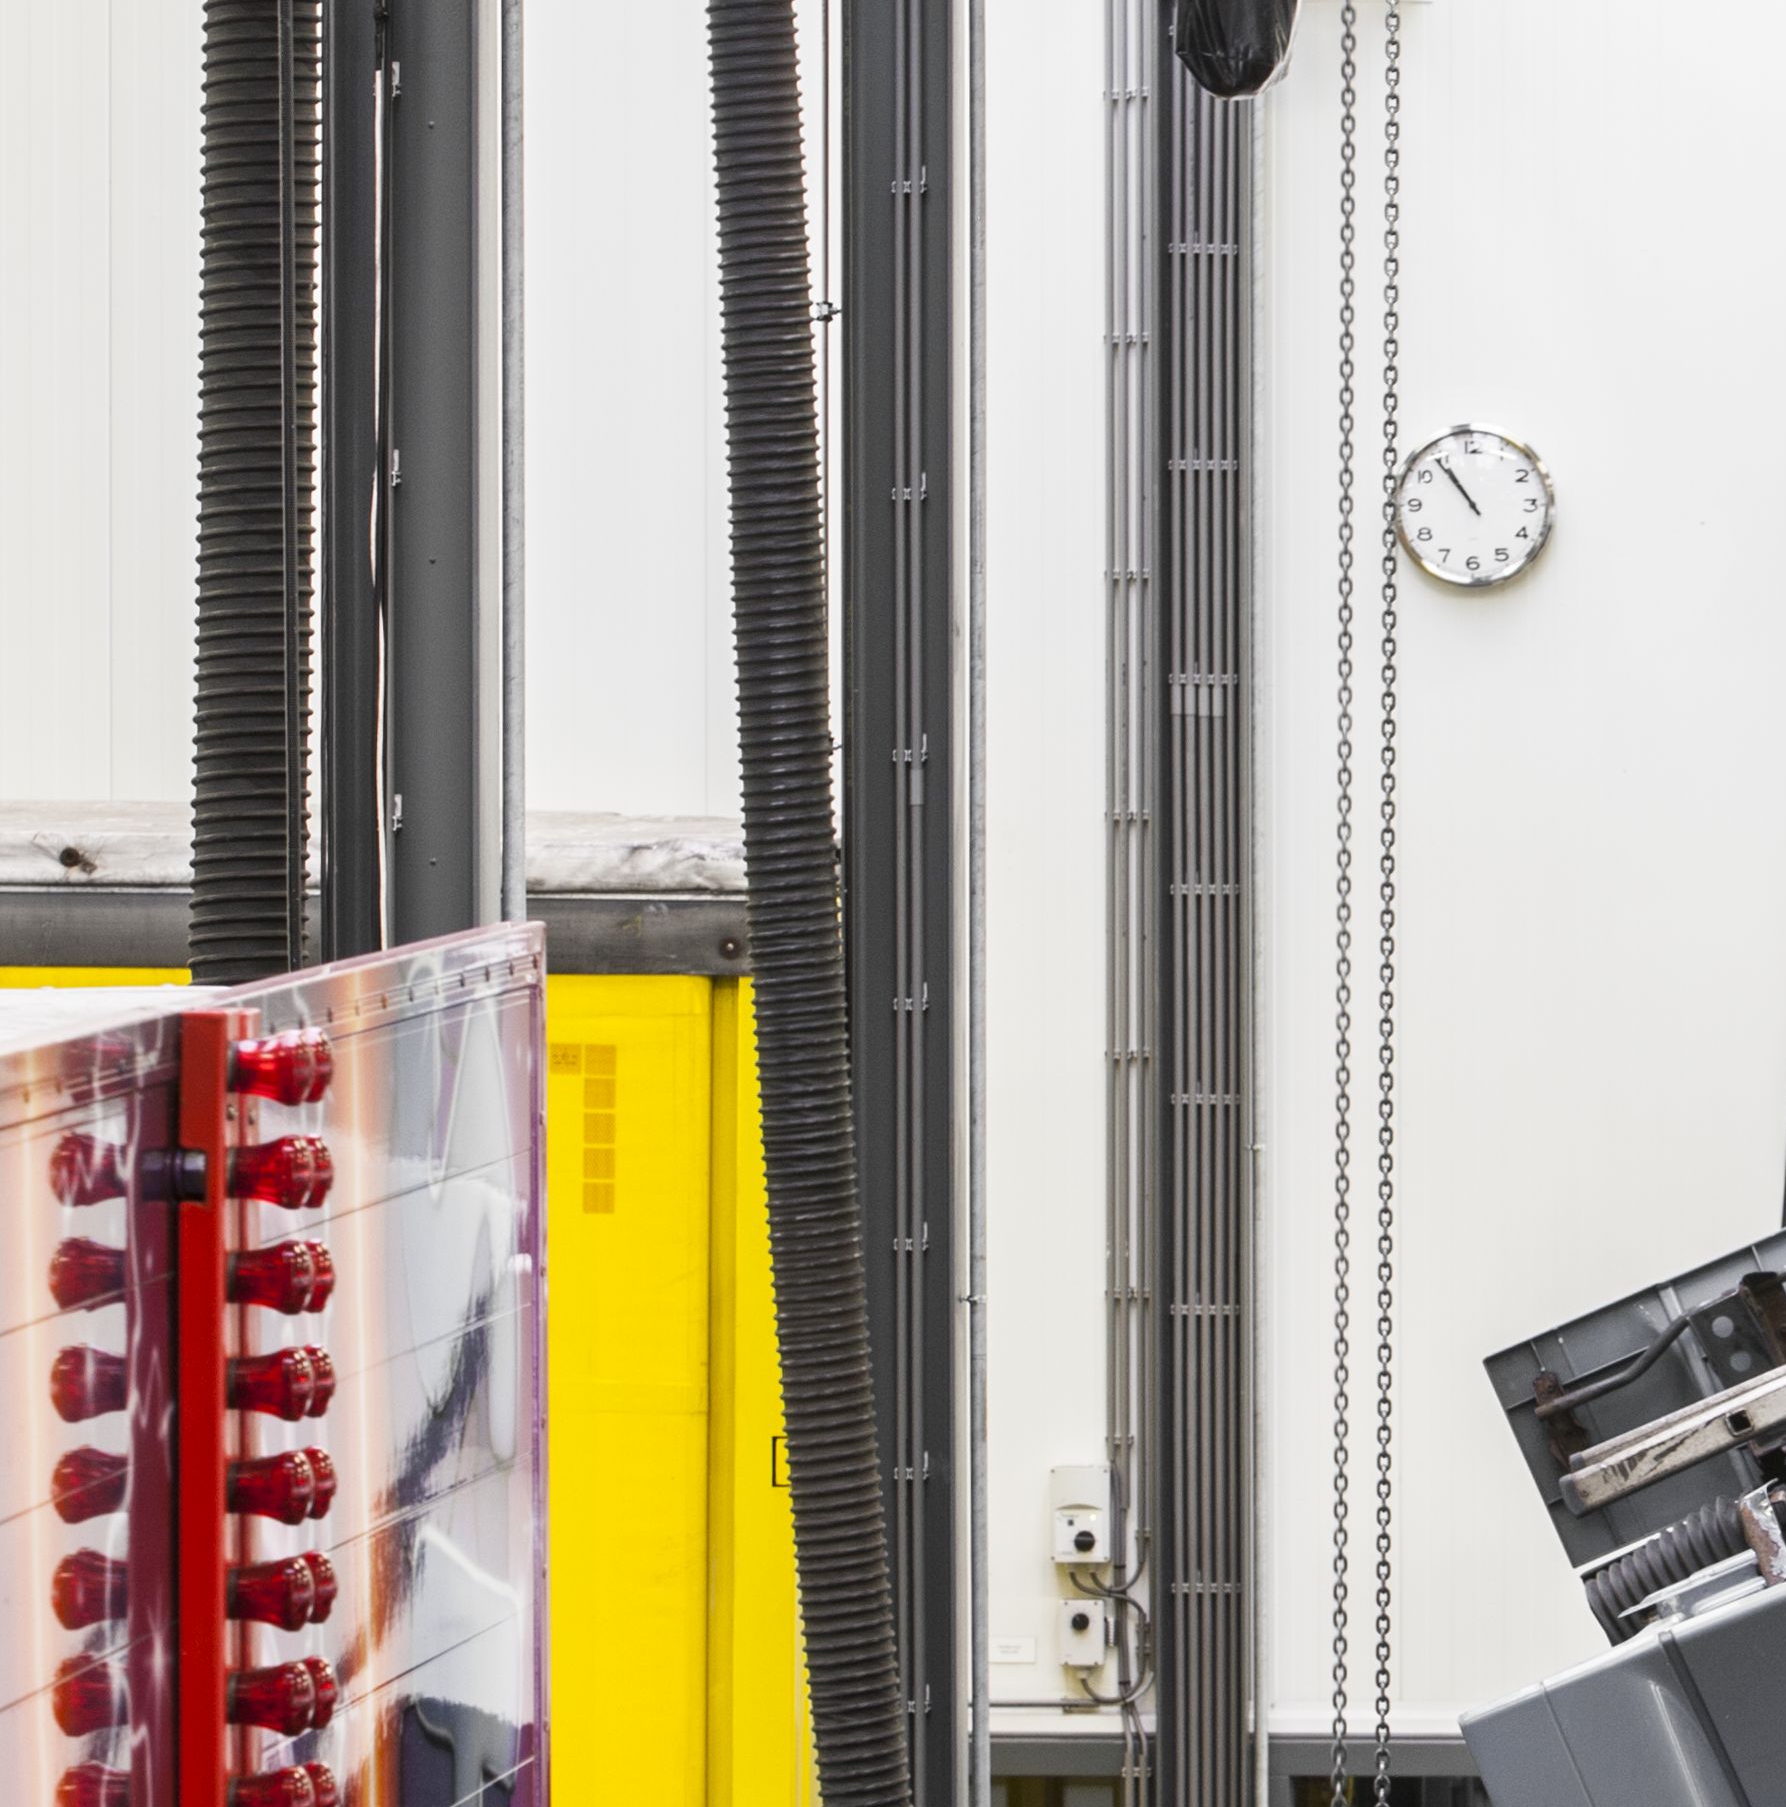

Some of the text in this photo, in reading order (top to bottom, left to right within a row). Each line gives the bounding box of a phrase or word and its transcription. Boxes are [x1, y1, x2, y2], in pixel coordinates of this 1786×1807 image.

[1464, 440, 1483, 454] 12
[1418, 470, 1433, 484] 10
[1515, 469, 1529, 483] 2
[1408, 498, 1423, 512] 9
[1523, 498, 1538, 513] 3
[1417, 527, 1433, 541] 8
[1515, 527, 1529, 539] 4
[1438, 549, 1451, 563] 7
[1494, 548, 1509, 562] 5
[1466, 556, 1480, 570] 6
